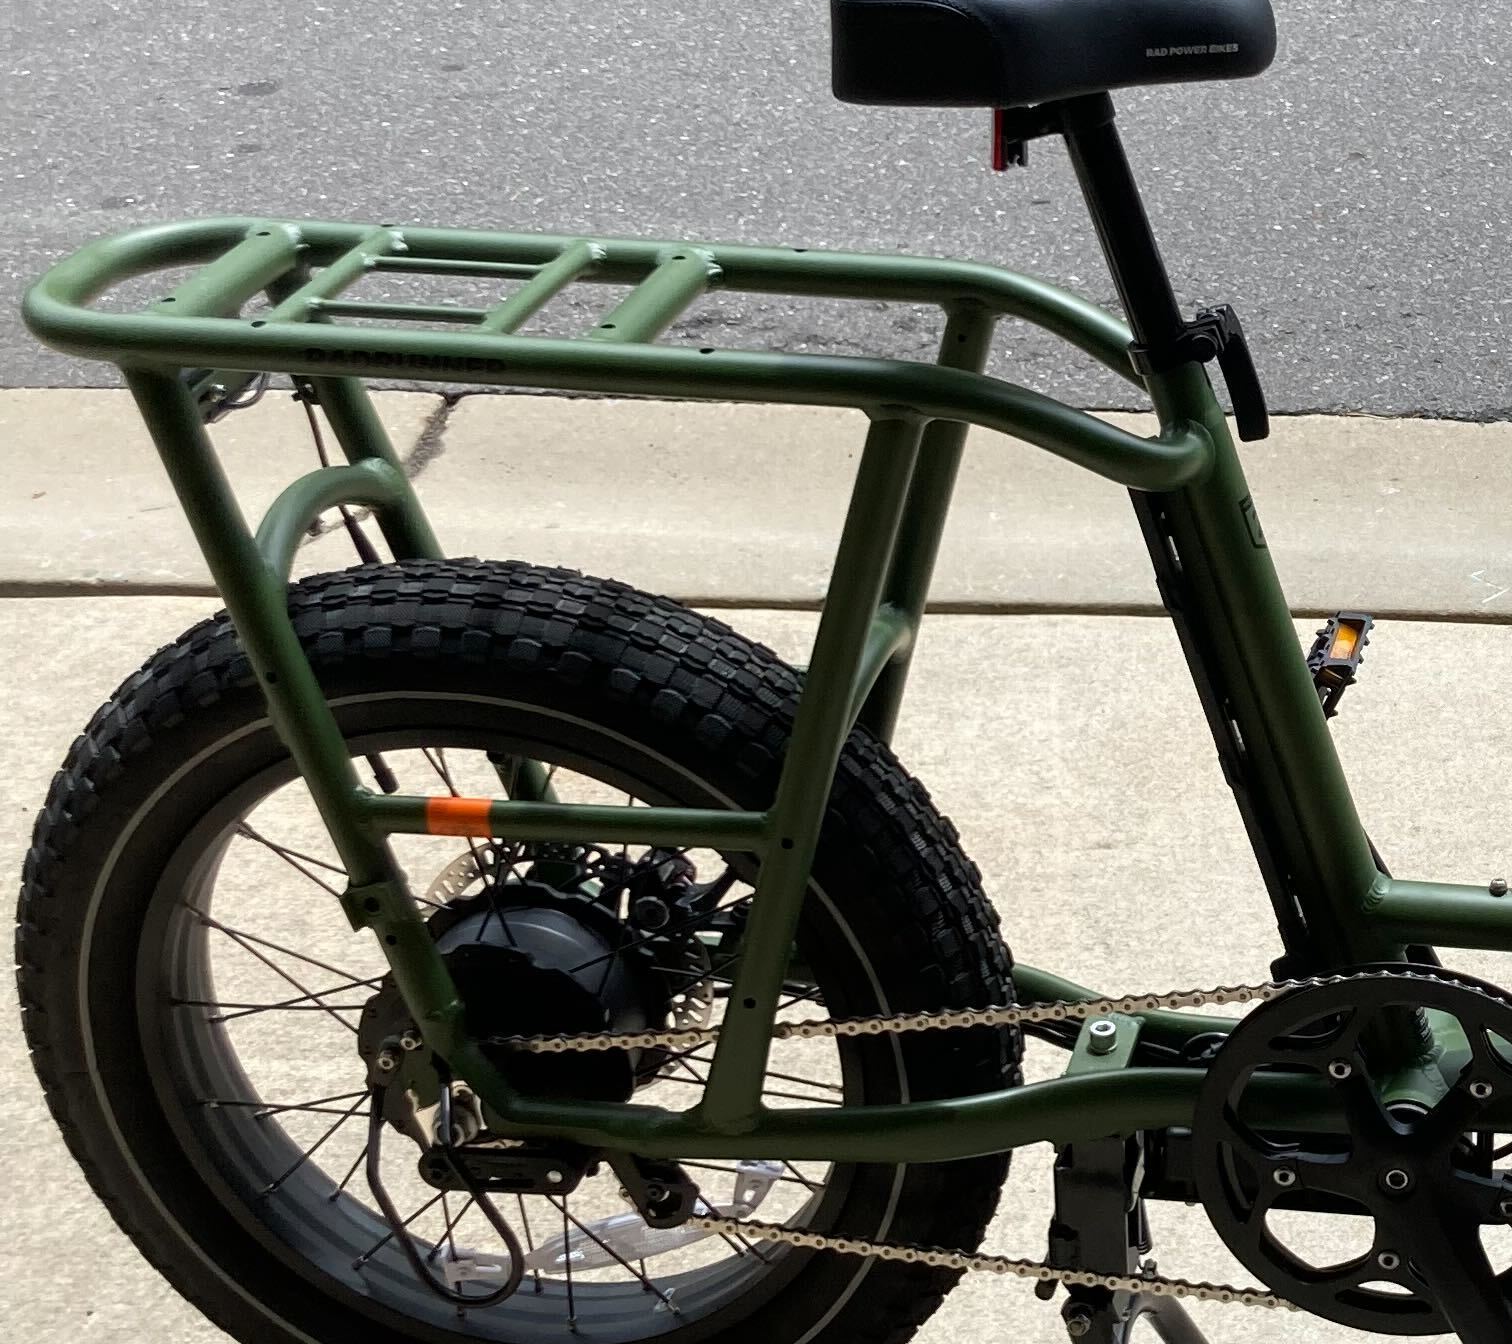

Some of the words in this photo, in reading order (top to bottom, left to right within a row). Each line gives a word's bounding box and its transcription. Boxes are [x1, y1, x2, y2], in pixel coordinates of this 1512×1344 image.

[1146, 47, 1168, 57] RAD
[1169, 45, 1207, 56] POWER
[1208, 43, 1239, 54] BIKES
